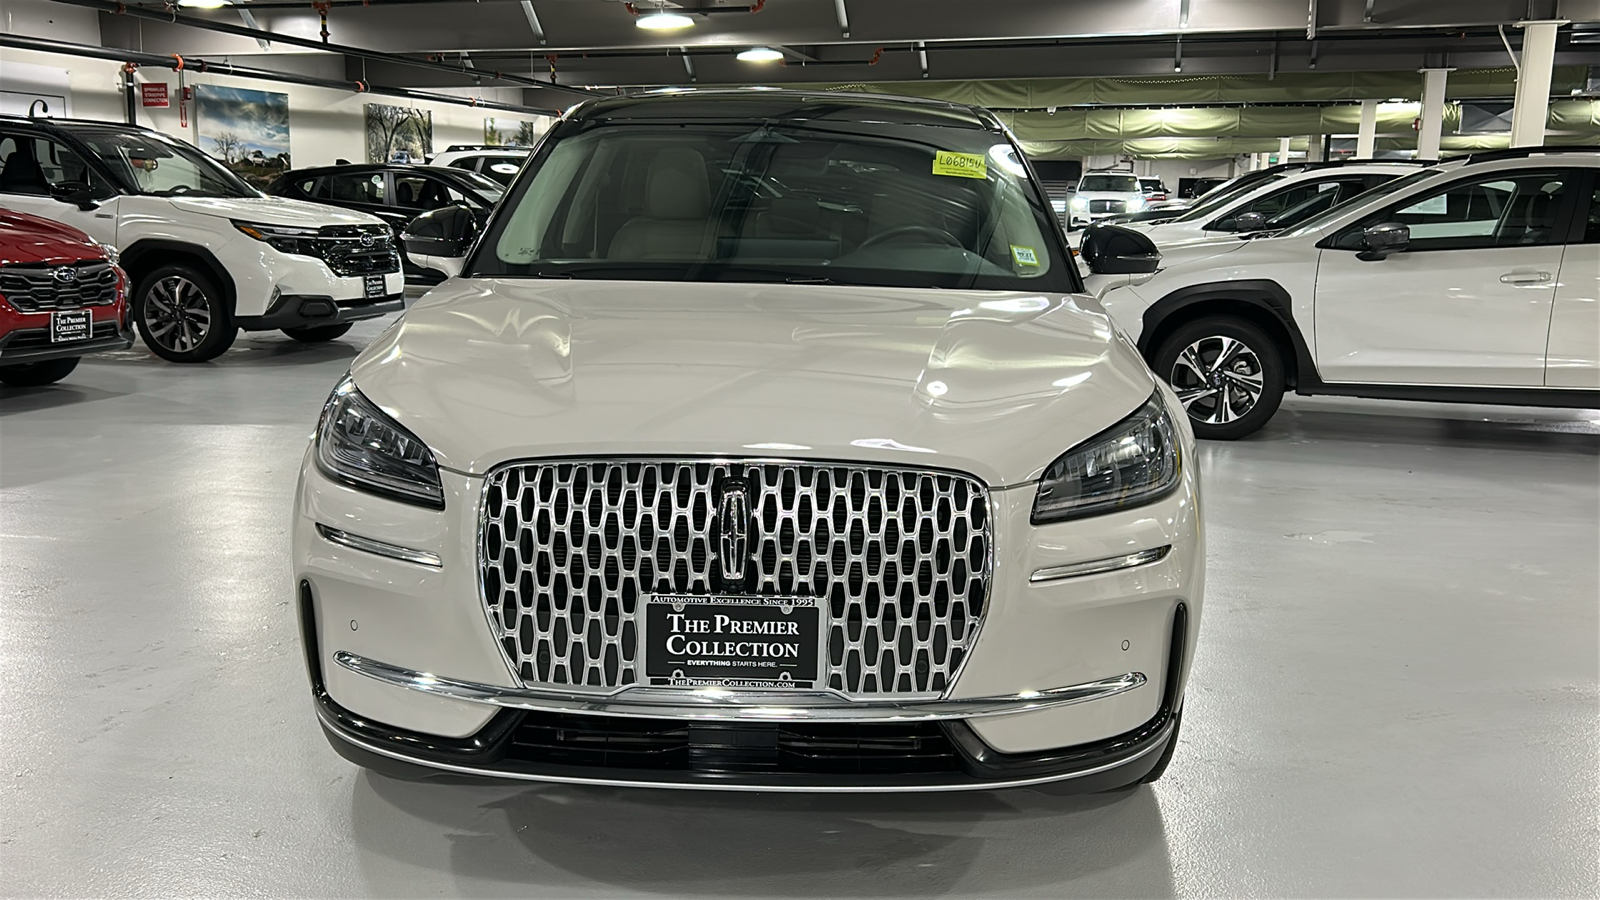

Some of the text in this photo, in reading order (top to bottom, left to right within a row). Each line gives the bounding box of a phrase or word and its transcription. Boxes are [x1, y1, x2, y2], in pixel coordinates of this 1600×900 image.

[652, 595, 708, 604] AUTOMOTIVE
[763, 598, 788, 606] SINCE
[791, 599, 814, 607] 1995
[666, 613, 800, 636] THE PREMIER
[665, 634, 800, 658] COLLECTION
[686, 659, 731, 667] EVERYTHING
[731, 660, 757, 668] STARTS
